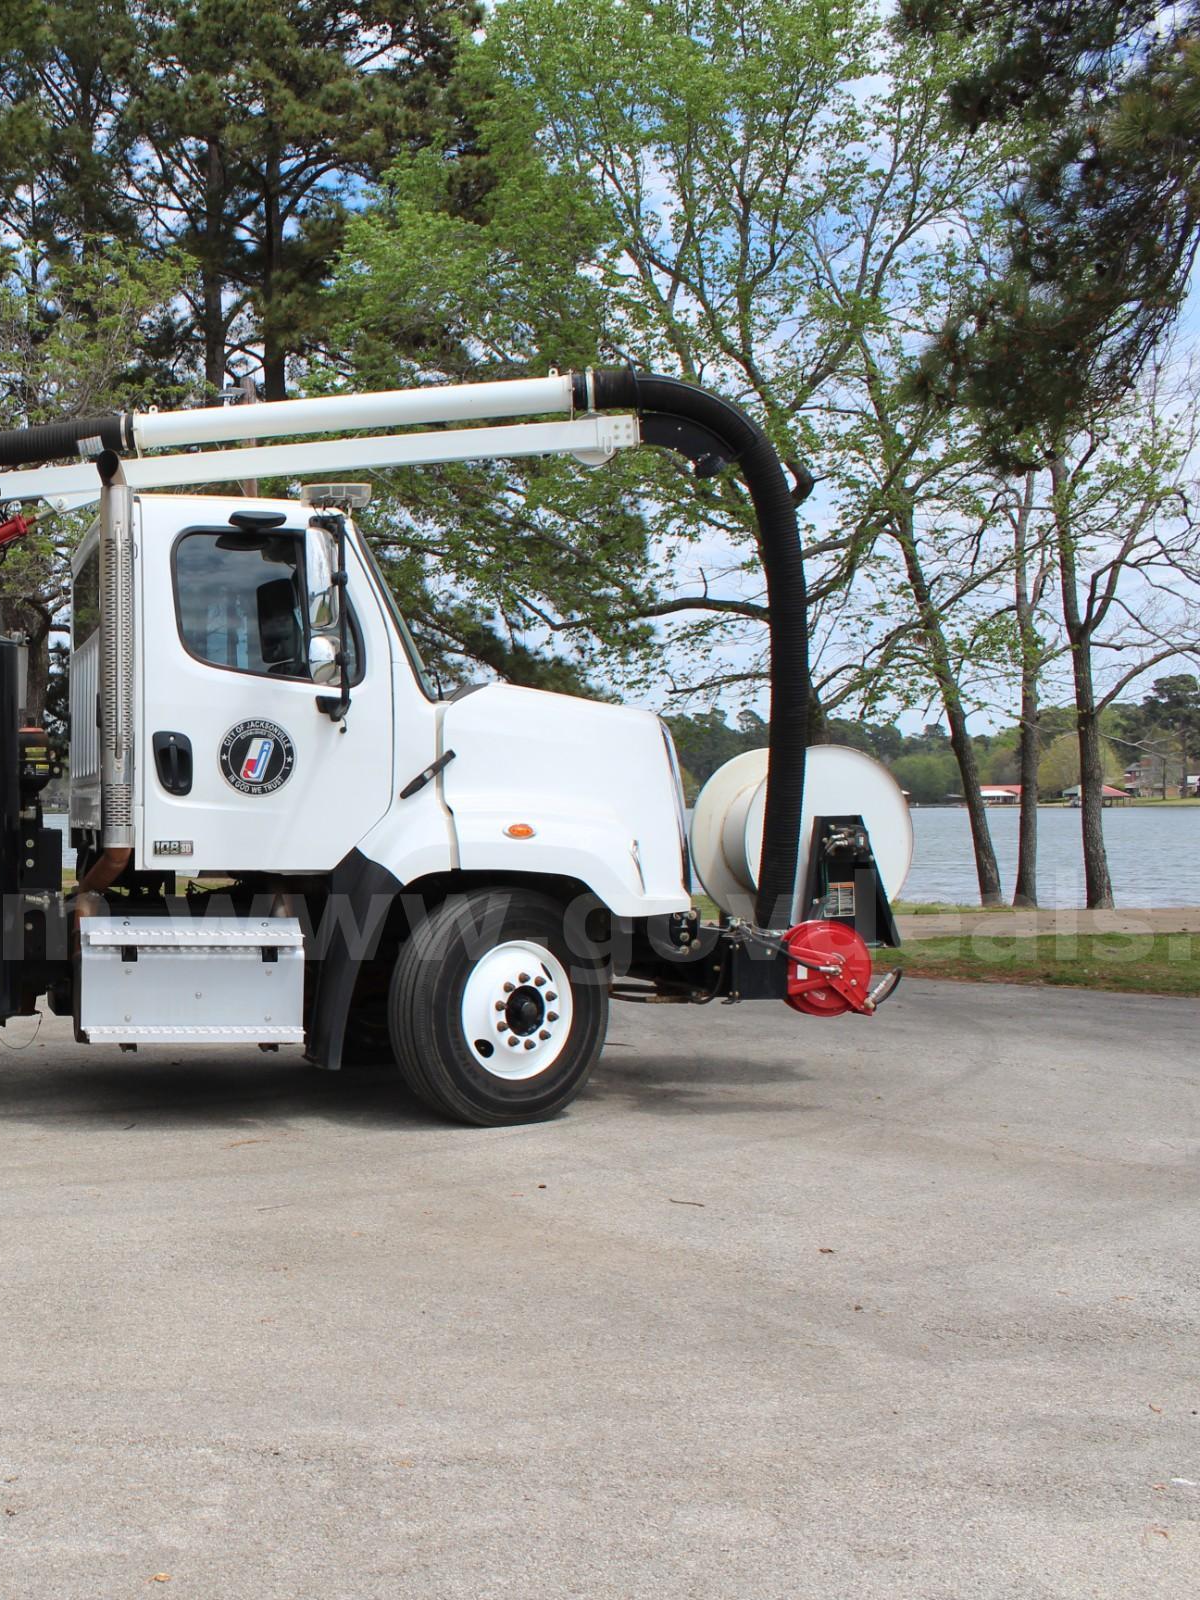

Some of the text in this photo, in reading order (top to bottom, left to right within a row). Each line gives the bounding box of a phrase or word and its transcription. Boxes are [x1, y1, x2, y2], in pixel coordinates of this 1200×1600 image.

[224, 731, 237, 747] CITY
[236, 724, 245, 733] OF
[246, 720, 292, 749] JACKSONVILLE
[228, 774, 285, 794] IN GOD WE TRUST
[155, 841, 180, 855] 108
